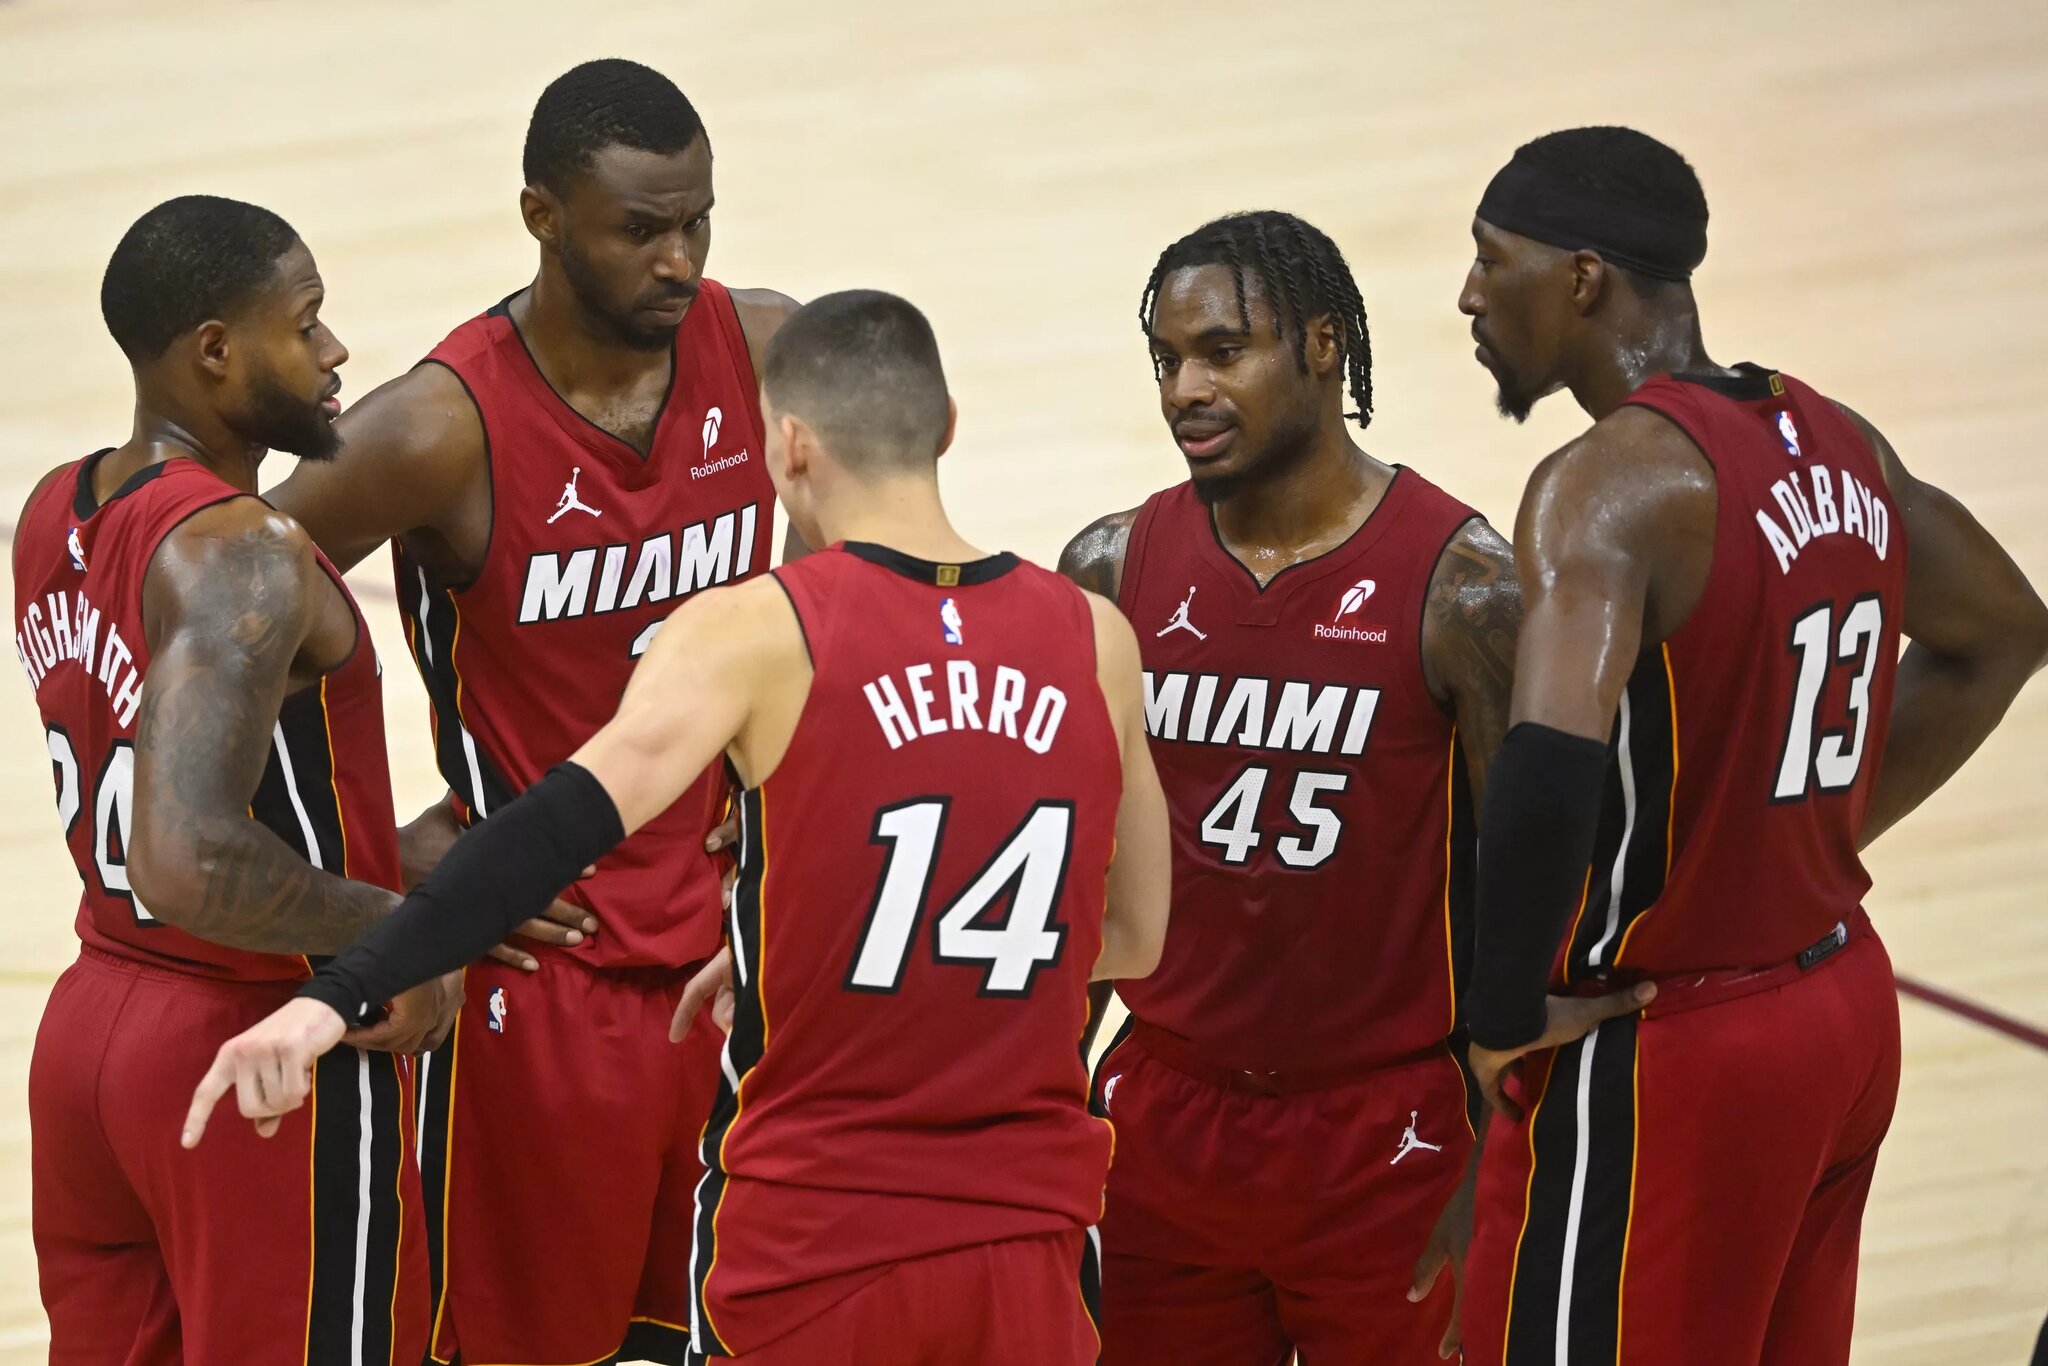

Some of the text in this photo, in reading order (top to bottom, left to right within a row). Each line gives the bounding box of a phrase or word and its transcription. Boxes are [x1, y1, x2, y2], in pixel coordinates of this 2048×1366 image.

[690, 449, 749, 480] Robinhood
[517, 502, 758, 624] MIAMI
[1755, 464, 1889, 575] ADEBAYO
[16, 590, 144, 730] HIGHSMITH
[1314, 624, 1387, 644] Robinhood
[862, 659, 1068, 755] HERRO
[1141, 669, 1382, 757] MIAMI
[1771, 593, 1884, 803] 13
[1199, 764, 1350, 869] 45
[845, 796, 1074, 996] 14
